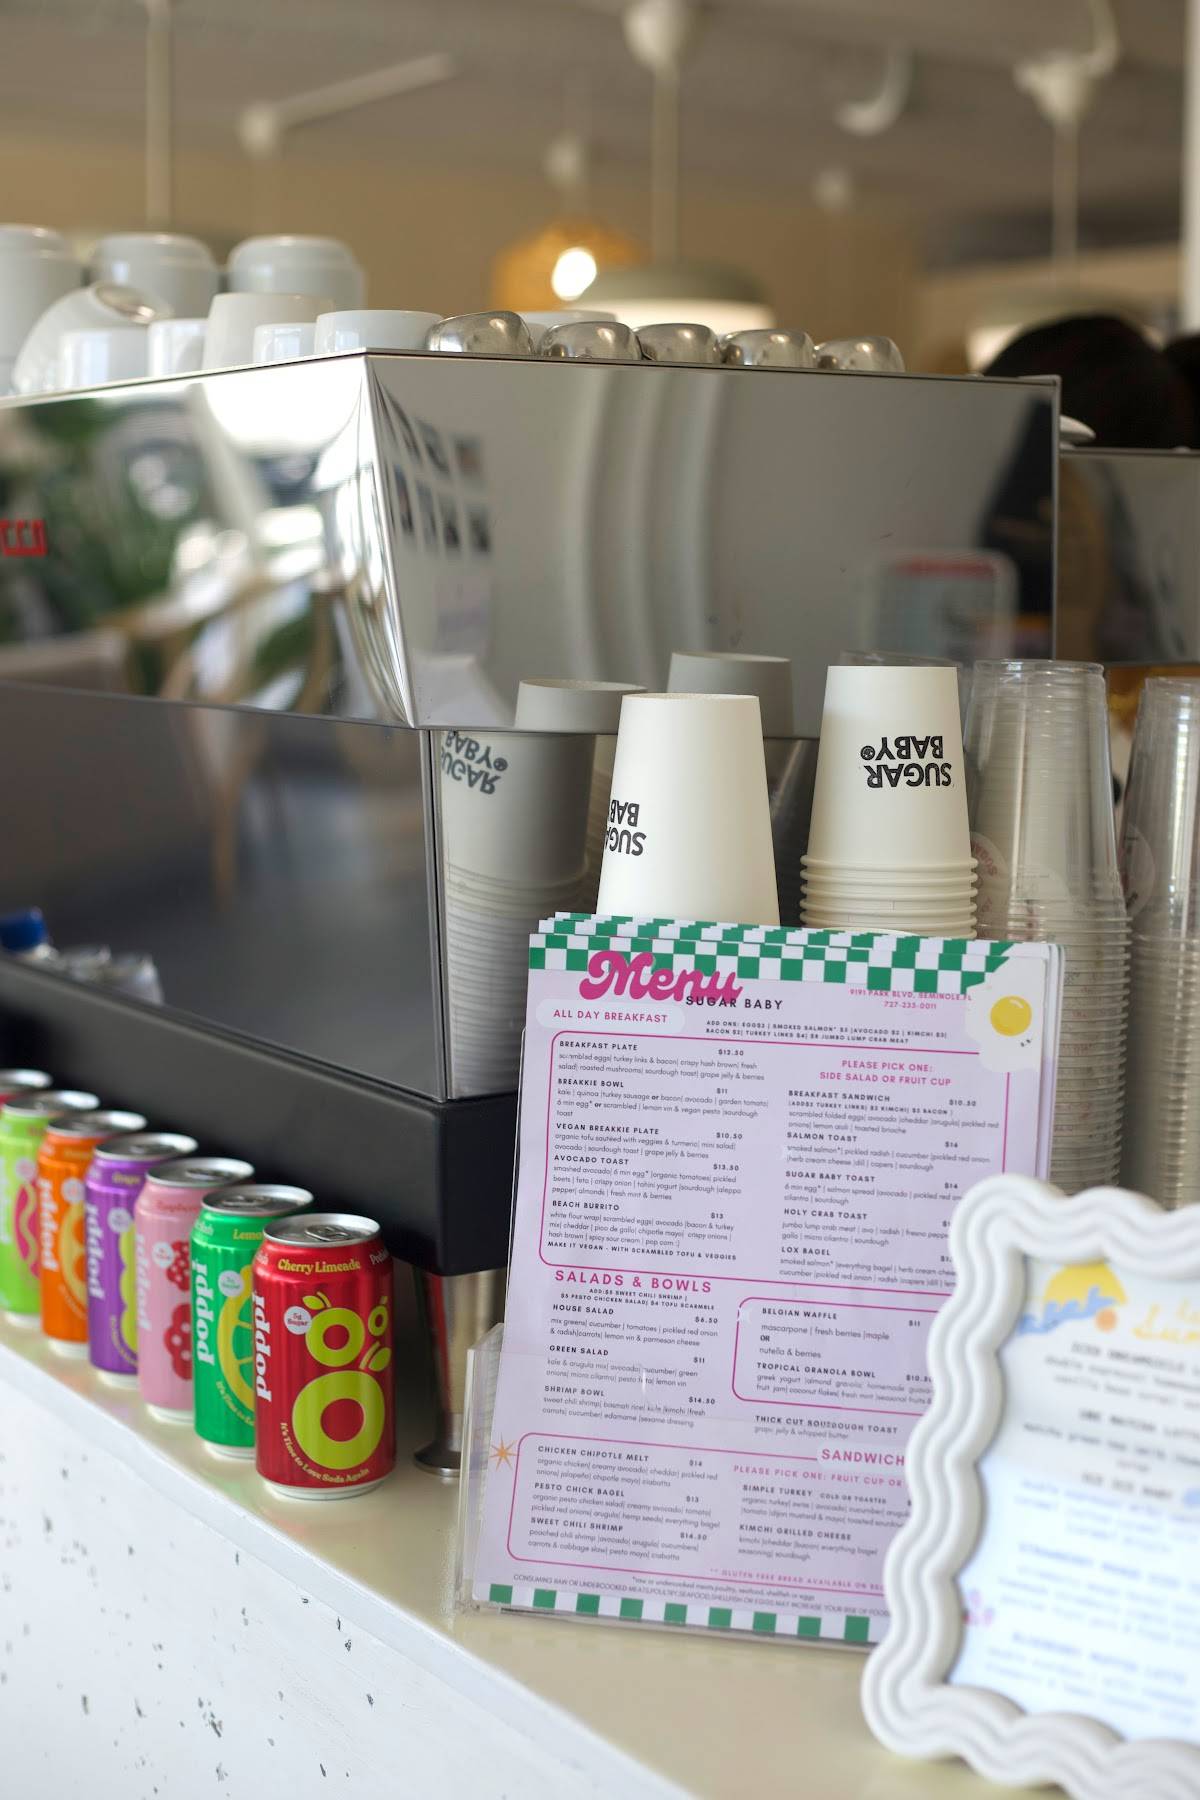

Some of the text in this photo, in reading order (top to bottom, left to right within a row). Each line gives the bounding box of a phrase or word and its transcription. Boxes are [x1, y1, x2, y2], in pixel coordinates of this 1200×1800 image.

[875, 735, 944, 760] BABY
[864, 762, 952, 788] SUGAR
[579, 950, 743, 1001] Menu
[685, 995, 784, 1011] SUGAR BABY
[553, 1009, 667, 1023] ALL DAY BREAKFAST
[559, 1040, 637, 1051] BREAKFAST PLATE
[613, 1055, 633, 1064] turkey
[841, 1059, 931, 1072] PLEASE PICK ONE:
[557, 1078, 597, 1086] BREAKKIE
[819, 1071, 951, 1086] SIDE SALAD OR FRUIT CUP
[788, 1090, 890, 1102] BREAKFAST SANDWICH
[556, 1122, 585, 1130] VEGAN
[589, 1124, 629, 1133] BREAKKIE
[787, 1131, 857, 1142] SALMON TOAST
[554, 1154, 629, 1165] AVOCADO TOAST
[785, 1170, 875, 1182] SUGAR BABY TOAST
[552, 1200, 620, 1211] BEACH BURRITO
[784, 1208, 807, 1216] HOLY
[838, 1211, 867, 1220] TOAST
[802, 1247, 830, 1255] BAGEL
[278, 1258, 314, 1276] Cherry
[315, 1257, 361, 1273] Limeade
[554, 1269, 711, 1293] SALADS & BOWLS
[192, 1258, 215, 1367] poppi
[553, 1304, 614, 1315] HOUSE SALAD
[762, 1307, 837, 1319] BELGIAN WAFFLE
[252, 1290, 273, 1402] poppi
[549, 1345, 608, 1356] GREEN SALAD
[786, 1348, 793, 1356] &
[757, 1362, 875, 1378] TROPICAL GRANOLA BOWL
[544, 1385, 604, 1396] SHRIMP BOWL
[755, 1415, 897, 1434] THICK CUT TOAST
[282, 1435, 297, 1458] Time
[537, 1445, 649, 1462] CHICKEN CHIPOTLE MELT
[821, 1448, 905, 1466] SANDWICH
[733, 1465, 770, 1475] PLEASE
[774, 1468, 798, 1478] PICK
[802, 1471, 825, 1480] ONE:
[831, 1473, 859, 1483] FRUIT
[863, 1476, 885, 1486] CUP
[534, 1482, 624, 1497] PESTO CHICK BAGEL
[742, 1484, 812, 1497] SIMPLE TURKEY
[531, 1516, 623, 1532] SWEET CHILI SHRIMP
[739, 1524, 851, 1540] KIMCHI GRILLED CHEESE
